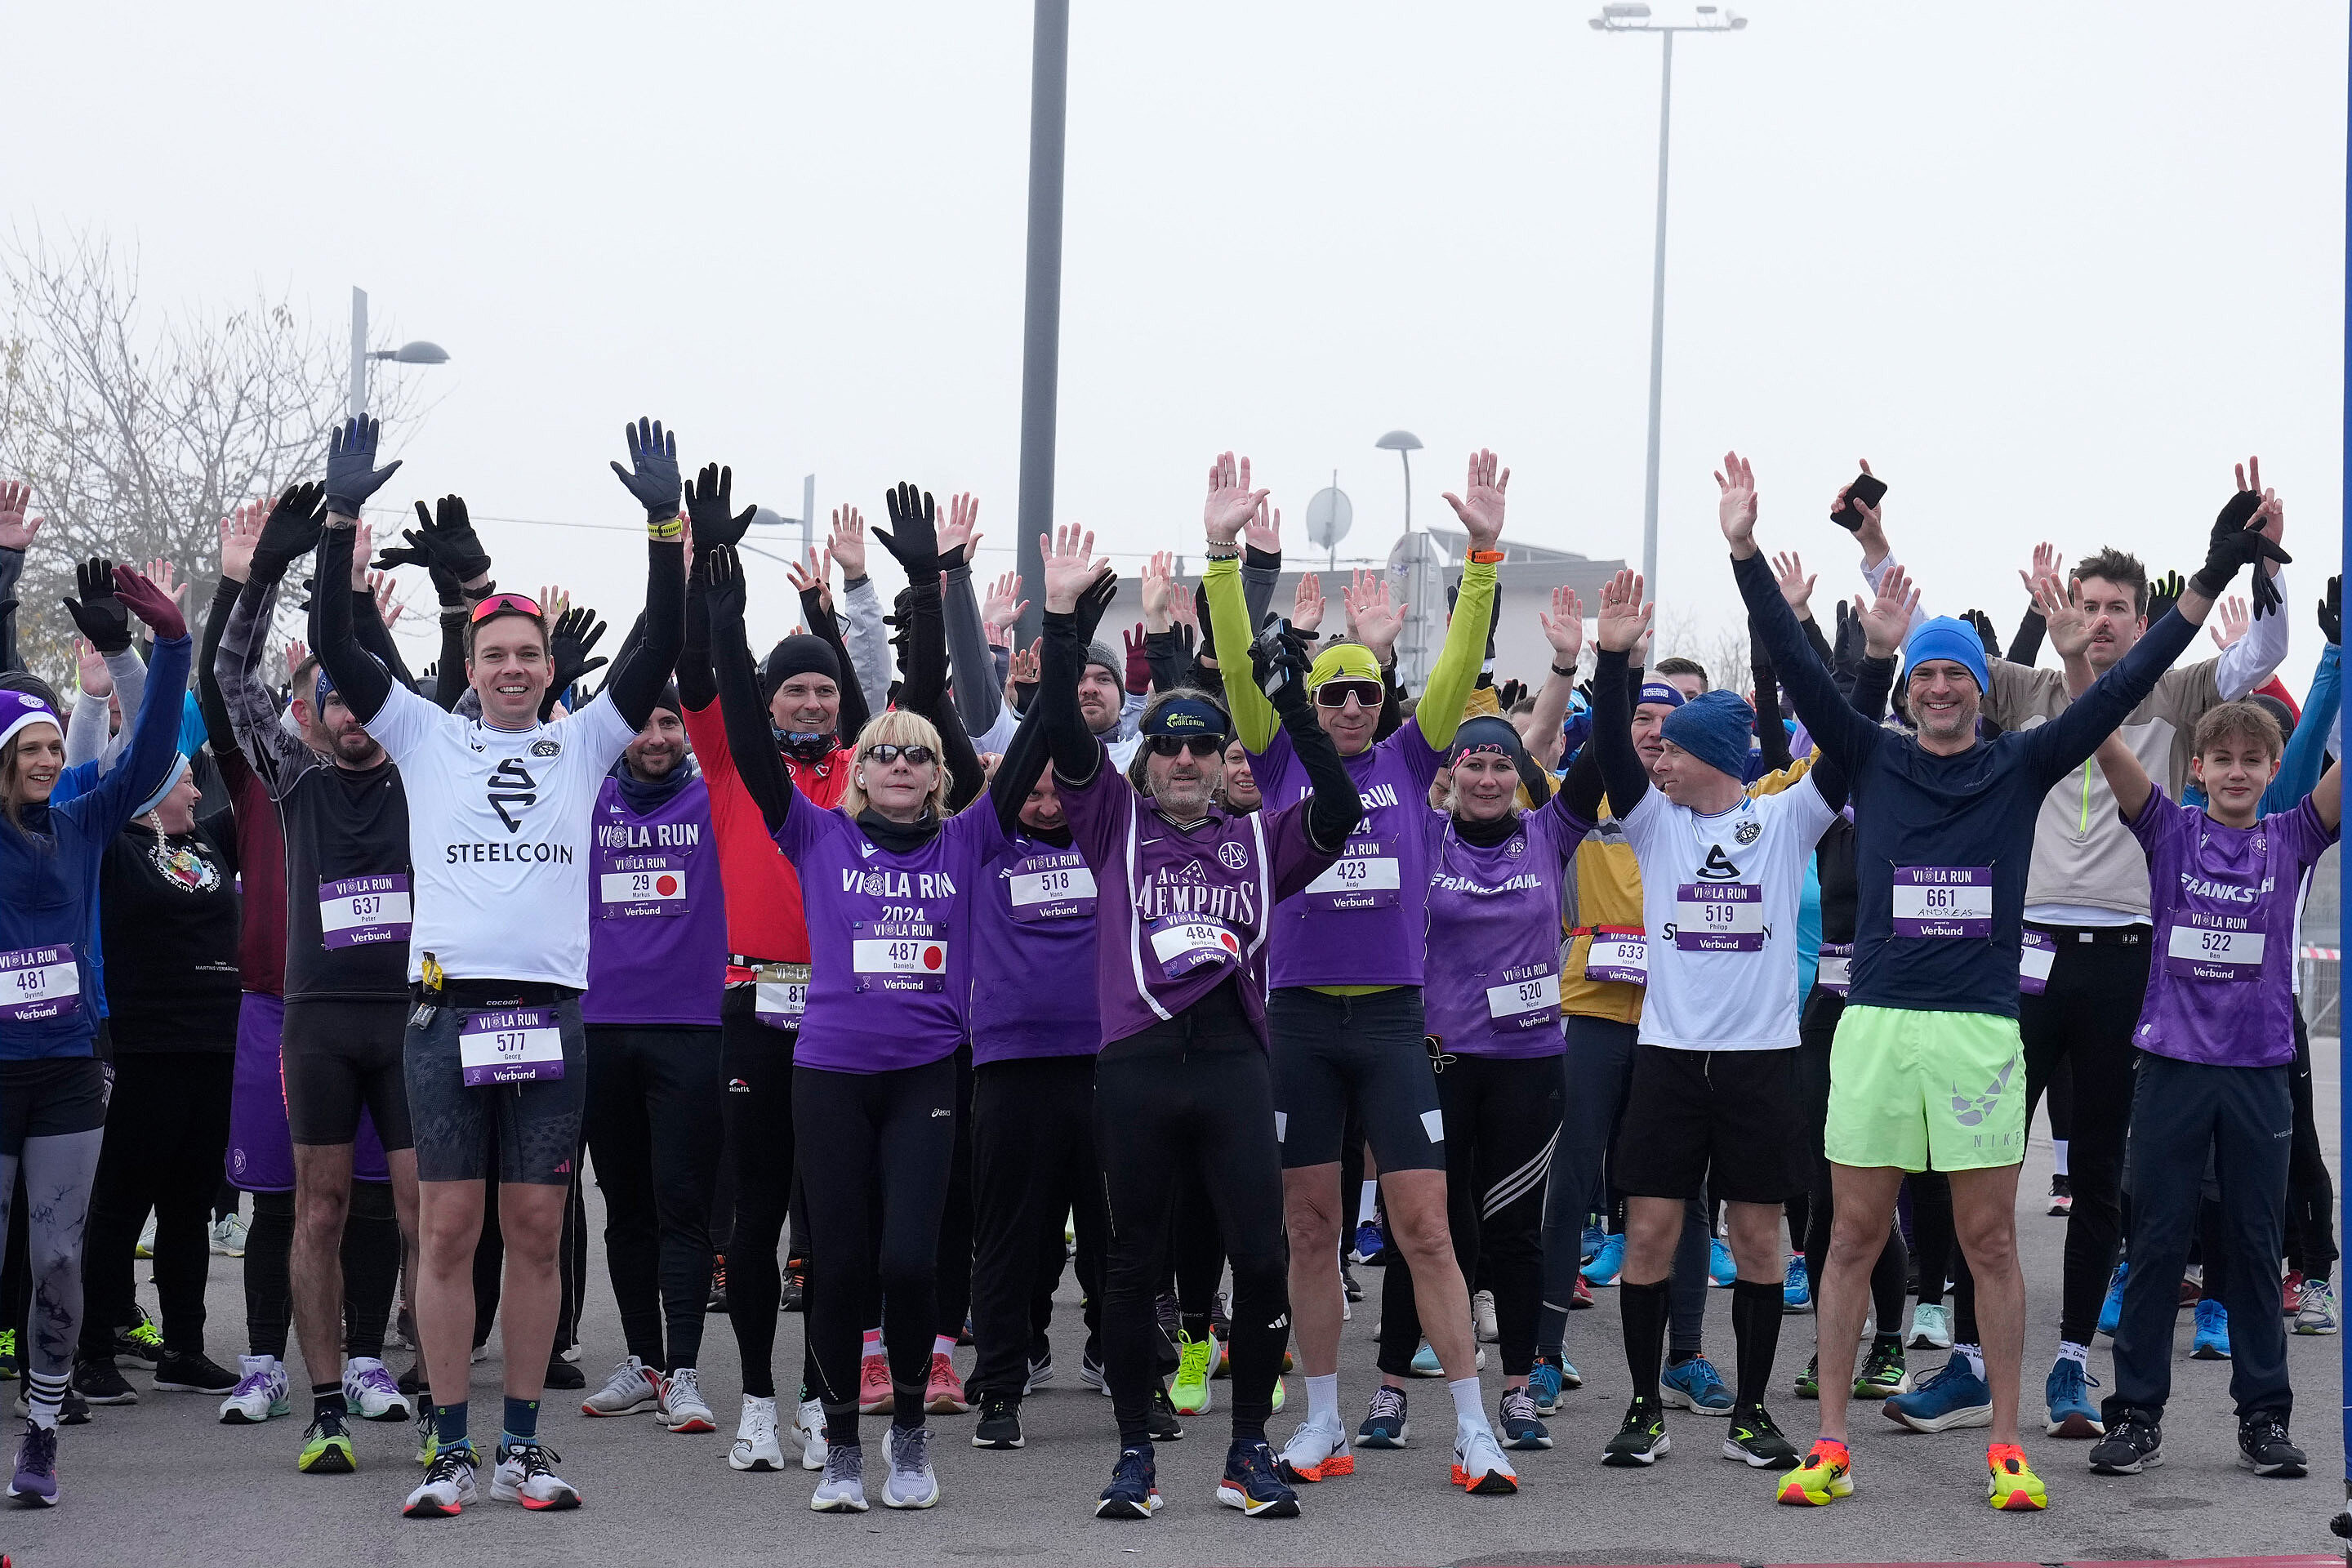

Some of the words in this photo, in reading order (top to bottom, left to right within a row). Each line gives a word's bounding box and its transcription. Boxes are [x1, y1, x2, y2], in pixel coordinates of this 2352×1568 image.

[1358, 784, 1399, 809] RUN
[1348, 817, 1371, 835] 24
[657, 824, 699, 846] RUN
[446, 843, 572, 865] STEELCOIN
[1358, 843, 1379, 856] RUN
[647, 858, 666, 869] RUN
[1060, 854, 1080, 866] RUN
[1337, 862, 1366, 880] 423
[1950, 871, 1971, 883] RUN
[372, 878, 393, 890] RUN
[632, 875, 649, 891] 29
[919, 872, 957, 898] RUN
[1041, 872, 1069, 891] 518
[2181, 873, 2274, 903] FRANKSTH
[1136, 875, 1254, 925] MEMPHIS
[1726, 888, 1748, 899] RUN
[1927, 889, 1955, 907] 661
[352, 896, 381, 915] 637
[1333, 896, 1374, 907] Verbund
[624, 906, 661, 916] Verbund
[881, 906, 925, 921] 2024
[1039, 904, 1078, 917] Verbund
[1705, 905, 1734, 922] 519
[1918, 908, 1973, 917] ANDREAS
[1202, 914, 1223, 927] RUN
[2225, 917, 2247, 929] RUN
[350, 930, 391, 943] Verbund
[911, 924, 933, 937] RUN
[1186, 926, 1215, 940] 484
[1920, 925, 1963, 936] Verbund
[1699, 939, 1739, 949] Verbund
[2022, 933, 2042, 946] RUN
[2202, 933, 2232, 951] 522
[37, 949, 58, 964] RUN
[889, 942, 919, 961] 487
[1188, 952, 1227, 965] Verbund
[1618, 944, 1644, 960] 633
[1533, 962, 1548, 976] RUN
[2193, 966, 2234, 979] Verbund
[16, 969, 46, 991] 481
[1608, 970, 1644, 984] Verbund
[883, 979, 924, 990] Verbund
[1519, 982, 1542, 1001] 520
[788, 985, 805, 1003] 81
[15, 1005, 57, 1020] Verbund
[518, 1013, 539, 1026] RUN
[1518, 1013, 1550, 1028] Verbund
[497, 1032, 526, 1052] 577
[493, 1069, 536, 1081] Verbund
[1974, 1131, 2020, 1147] NIKE
[2274, 1130, 2291, 1139] HEA
